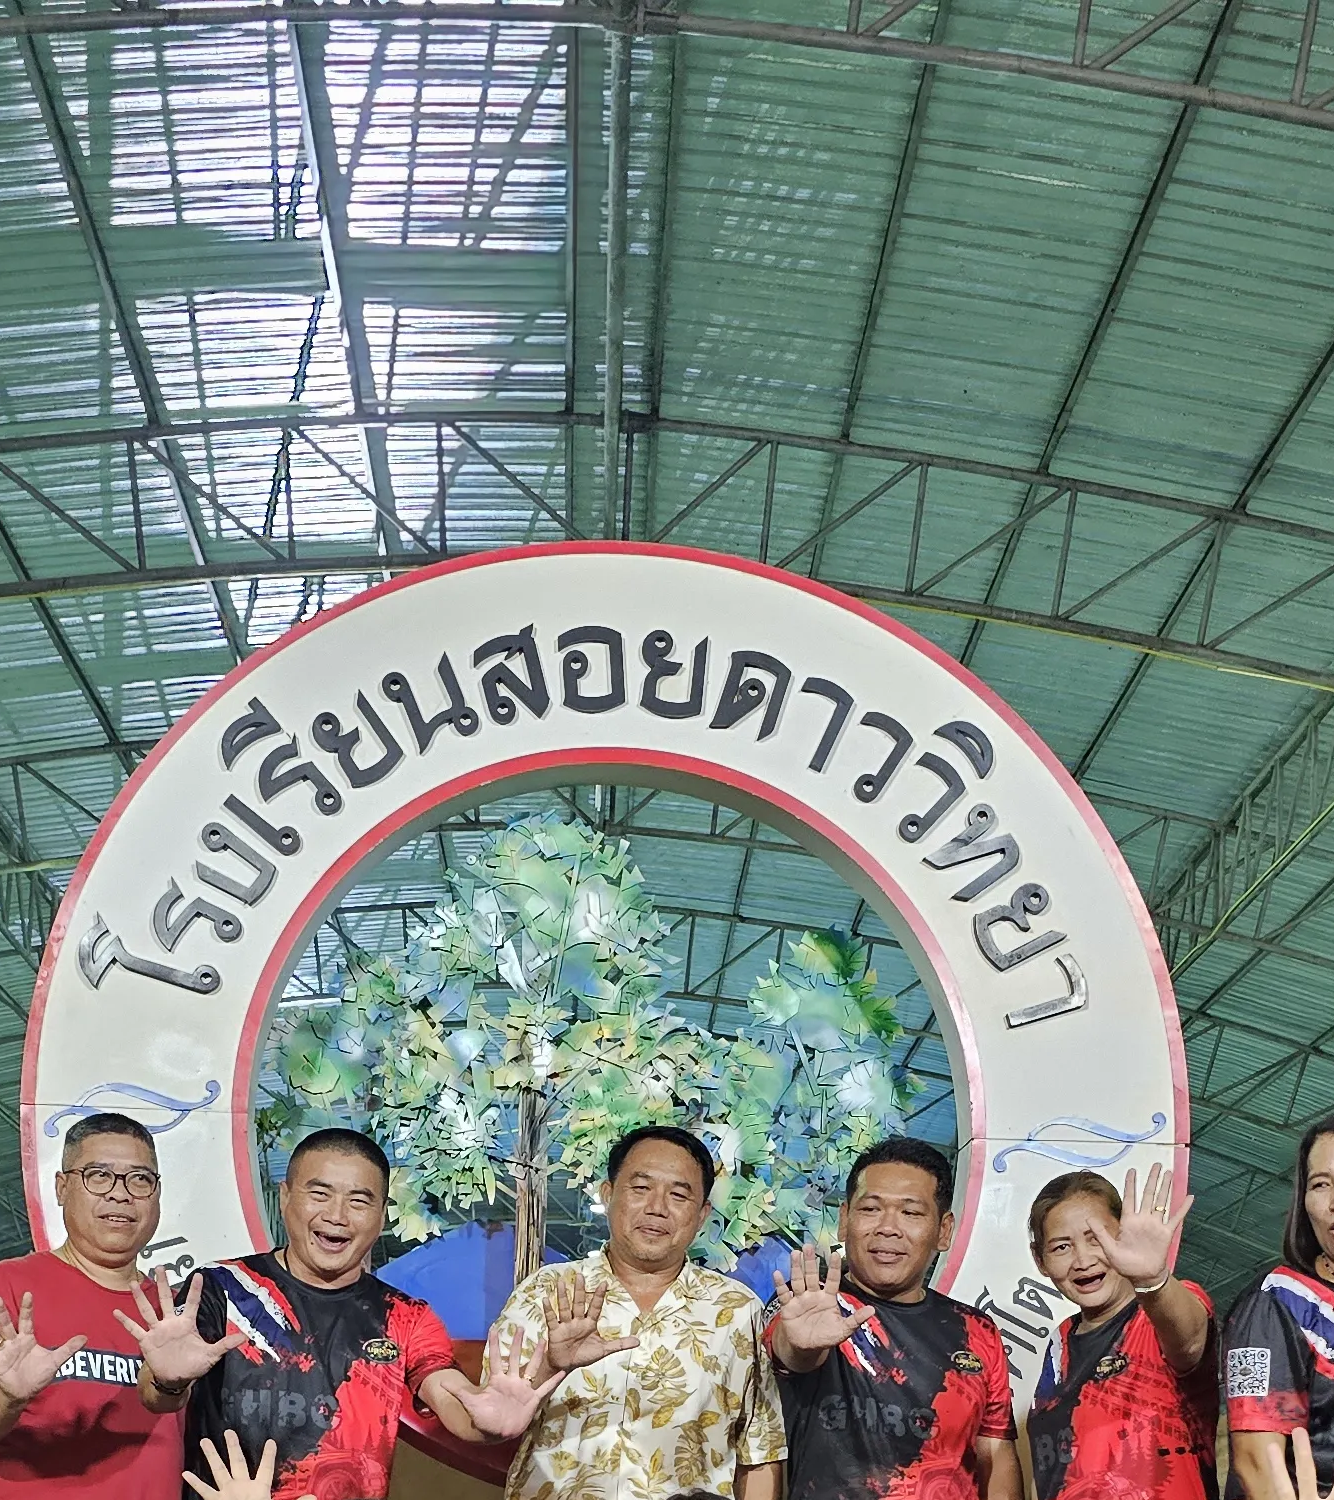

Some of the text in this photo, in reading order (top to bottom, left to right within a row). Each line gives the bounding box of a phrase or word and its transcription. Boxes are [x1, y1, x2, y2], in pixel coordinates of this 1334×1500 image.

[77, 622, 1090, 1030] โรงเรียนสอยดาววิทยา
[56, 1350, 142, 1384] BEVERL
